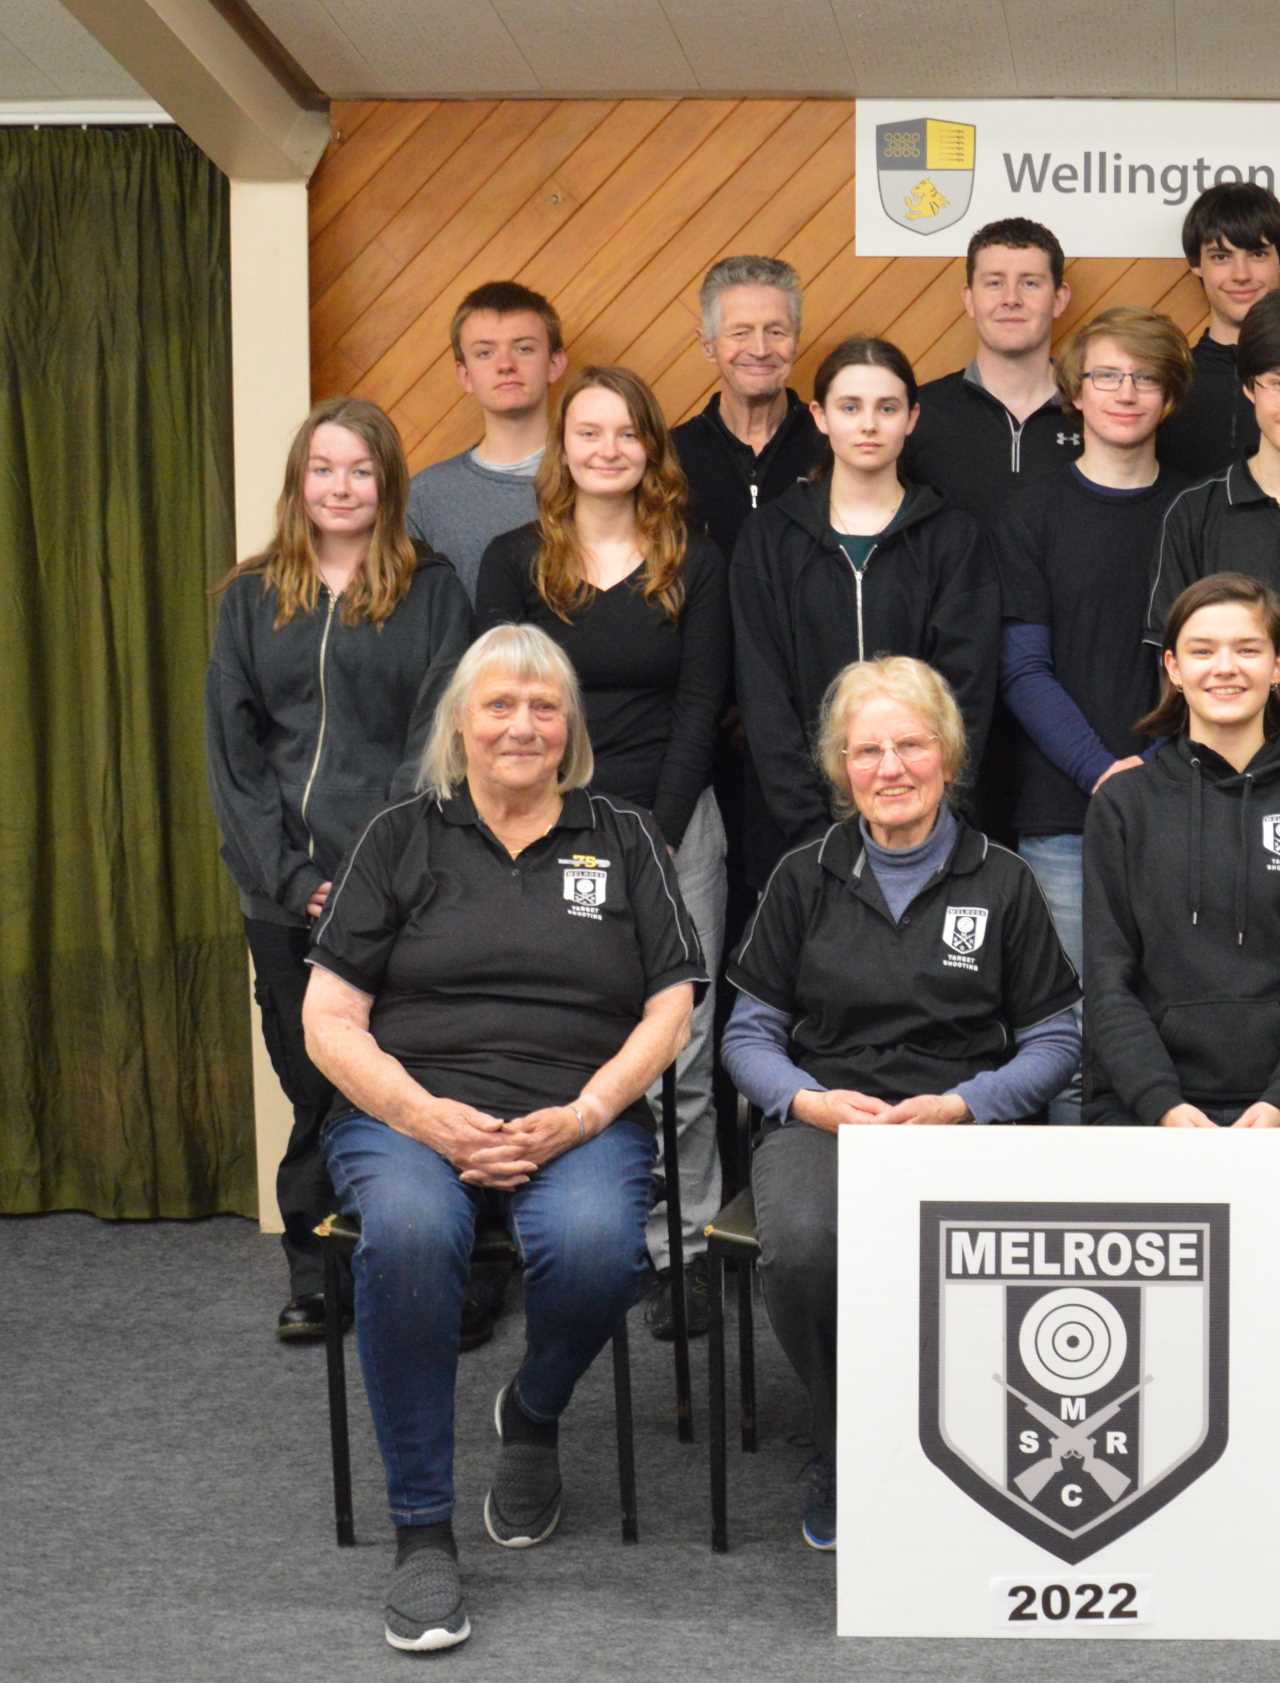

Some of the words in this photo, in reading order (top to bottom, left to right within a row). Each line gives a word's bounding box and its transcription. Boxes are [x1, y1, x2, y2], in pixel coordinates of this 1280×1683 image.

[1003, 151, 1275, 206] Wellington
[951, 1231, 1198, 1277] MELROSE
[1060, 1397, 1086, 1421] M
[1018, 1430, 1040, 1454] S
[1105, 1431, 1129, 1455] R
[1061, 1483, 1083, 1508] C
[1007, 1582, 1138, 1621] 2022
